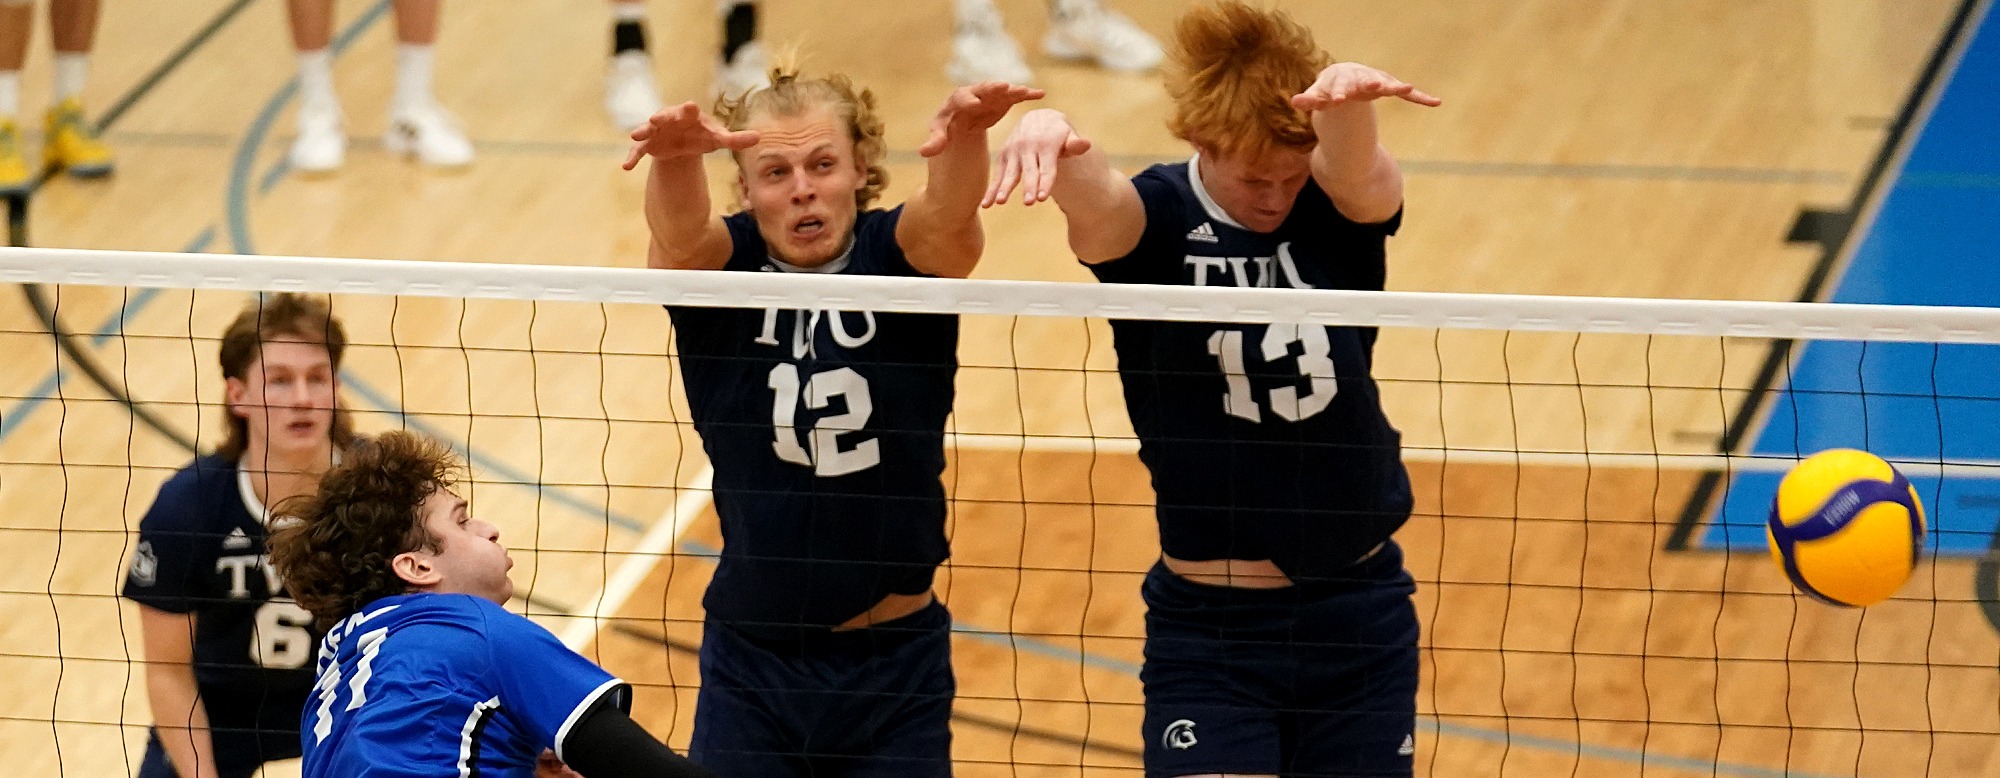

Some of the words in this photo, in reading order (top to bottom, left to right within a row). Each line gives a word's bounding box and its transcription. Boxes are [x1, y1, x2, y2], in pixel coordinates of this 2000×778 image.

[767, 362, 881, 477] 12
[1207, 322, 1338, 423] 13
[249, 597, 313, 670] 6
